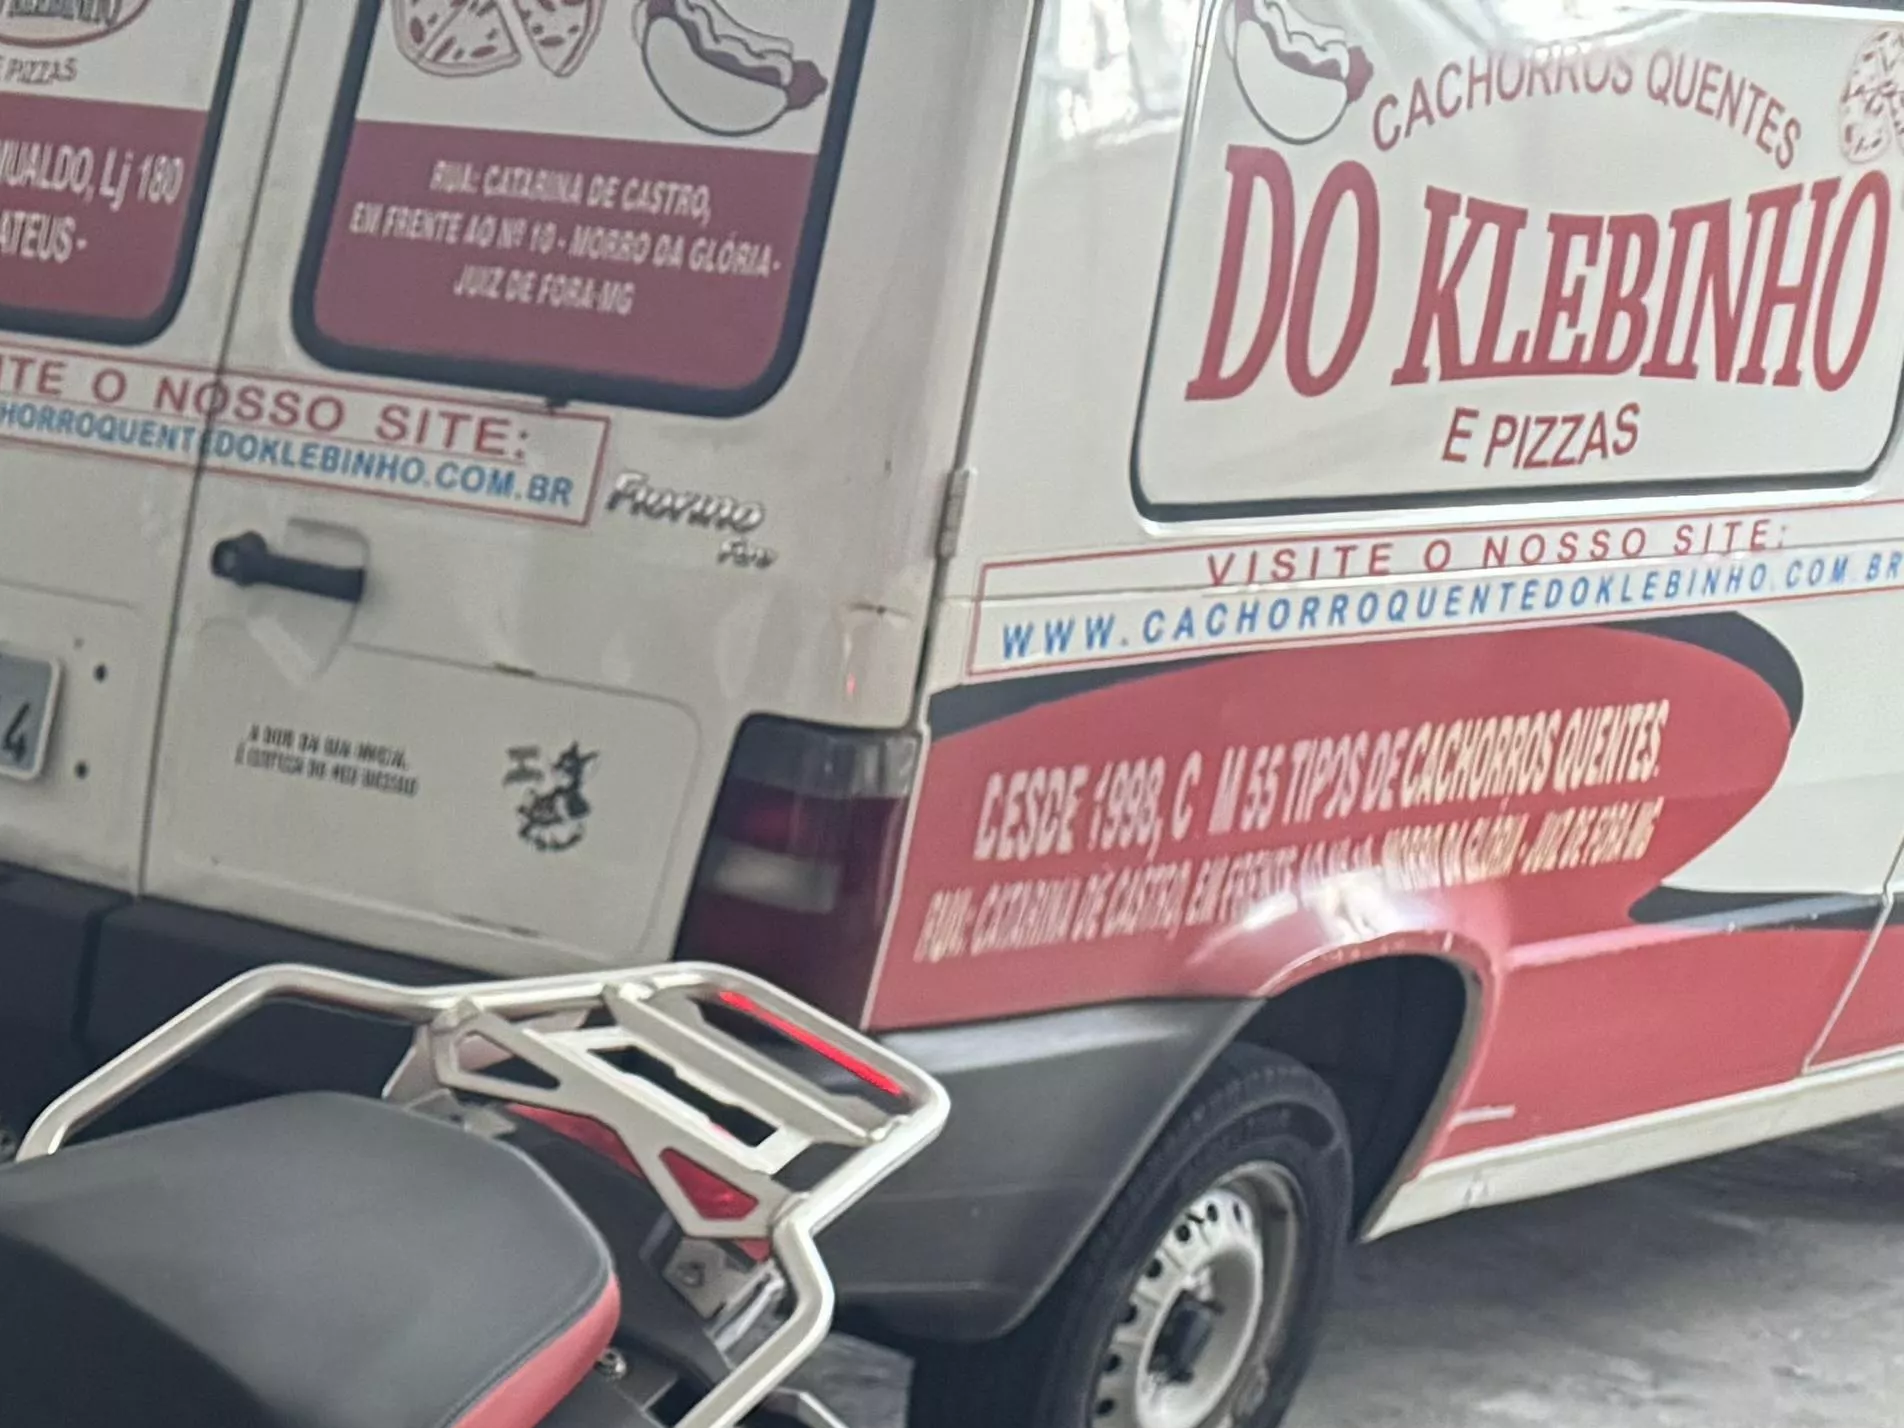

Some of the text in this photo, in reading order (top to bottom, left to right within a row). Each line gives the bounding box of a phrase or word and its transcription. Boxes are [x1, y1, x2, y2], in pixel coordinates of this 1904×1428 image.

[1372, 44, 1802, 169] CACHORROS QUENTES
[136, 154, 185, 204] 180
[1185, 145, 1890, 402] DO KLEBINHO
[92, 368, 127, 405] O
[153, 377, 346, 433] NOSSO
[375, 404, 530, 461] SITE:
[1443, 402, 1639, 470] E PIZZAS
[1207, 518, 1789, 587] VISITE O NOSSO SITE:
[1171, 746, 1249, 841] CM
[1282, 730, 1370, 824] TIPOS
[1361, 728, 1410, 813] DE
[1401, 709, 1563, 808] CACHORROS
